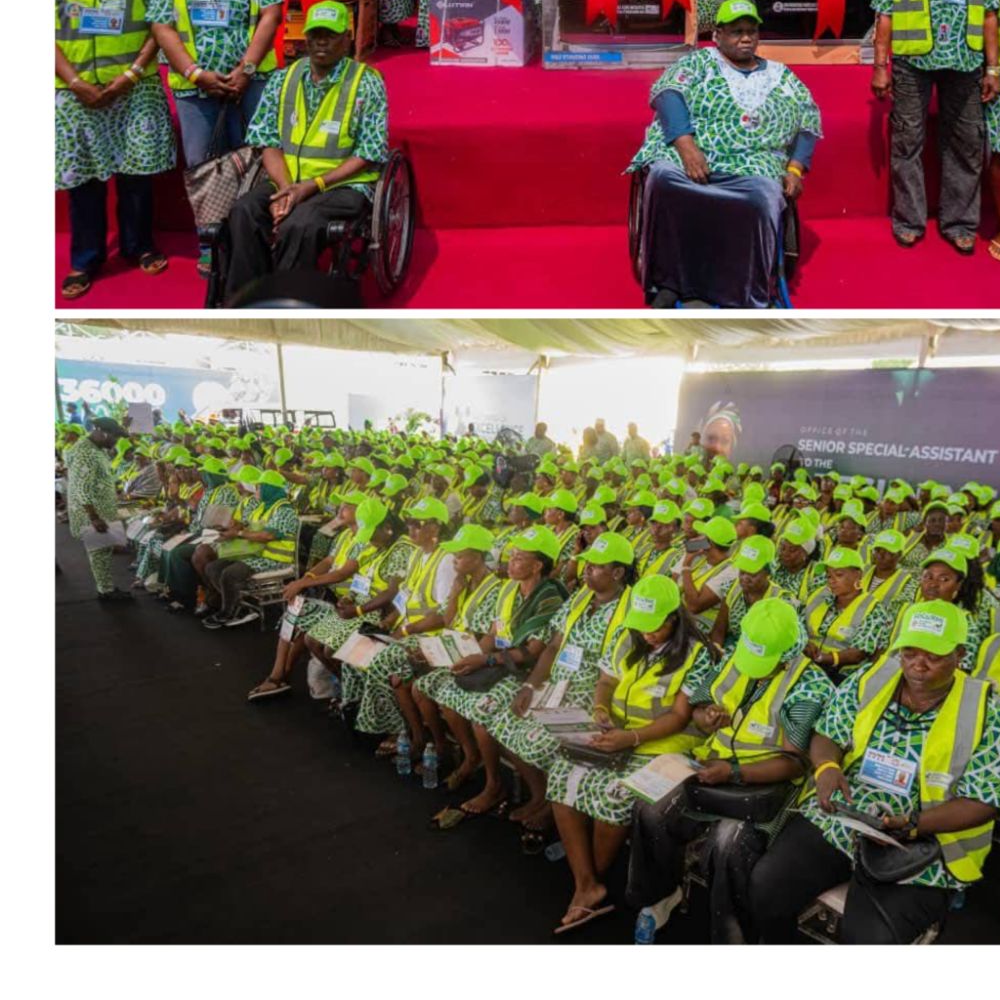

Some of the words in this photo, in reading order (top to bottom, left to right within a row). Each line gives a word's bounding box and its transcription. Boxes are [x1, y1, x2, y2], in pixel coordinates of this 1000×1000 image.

[58, 378, 166, 406] 36000
[797, 439, 846, 454] SENIOR
[848, 442, 906, 458] SPECIAL
[908, 446, 999, 465] ASSISTANT
[814, 458, 833, 469] THE
